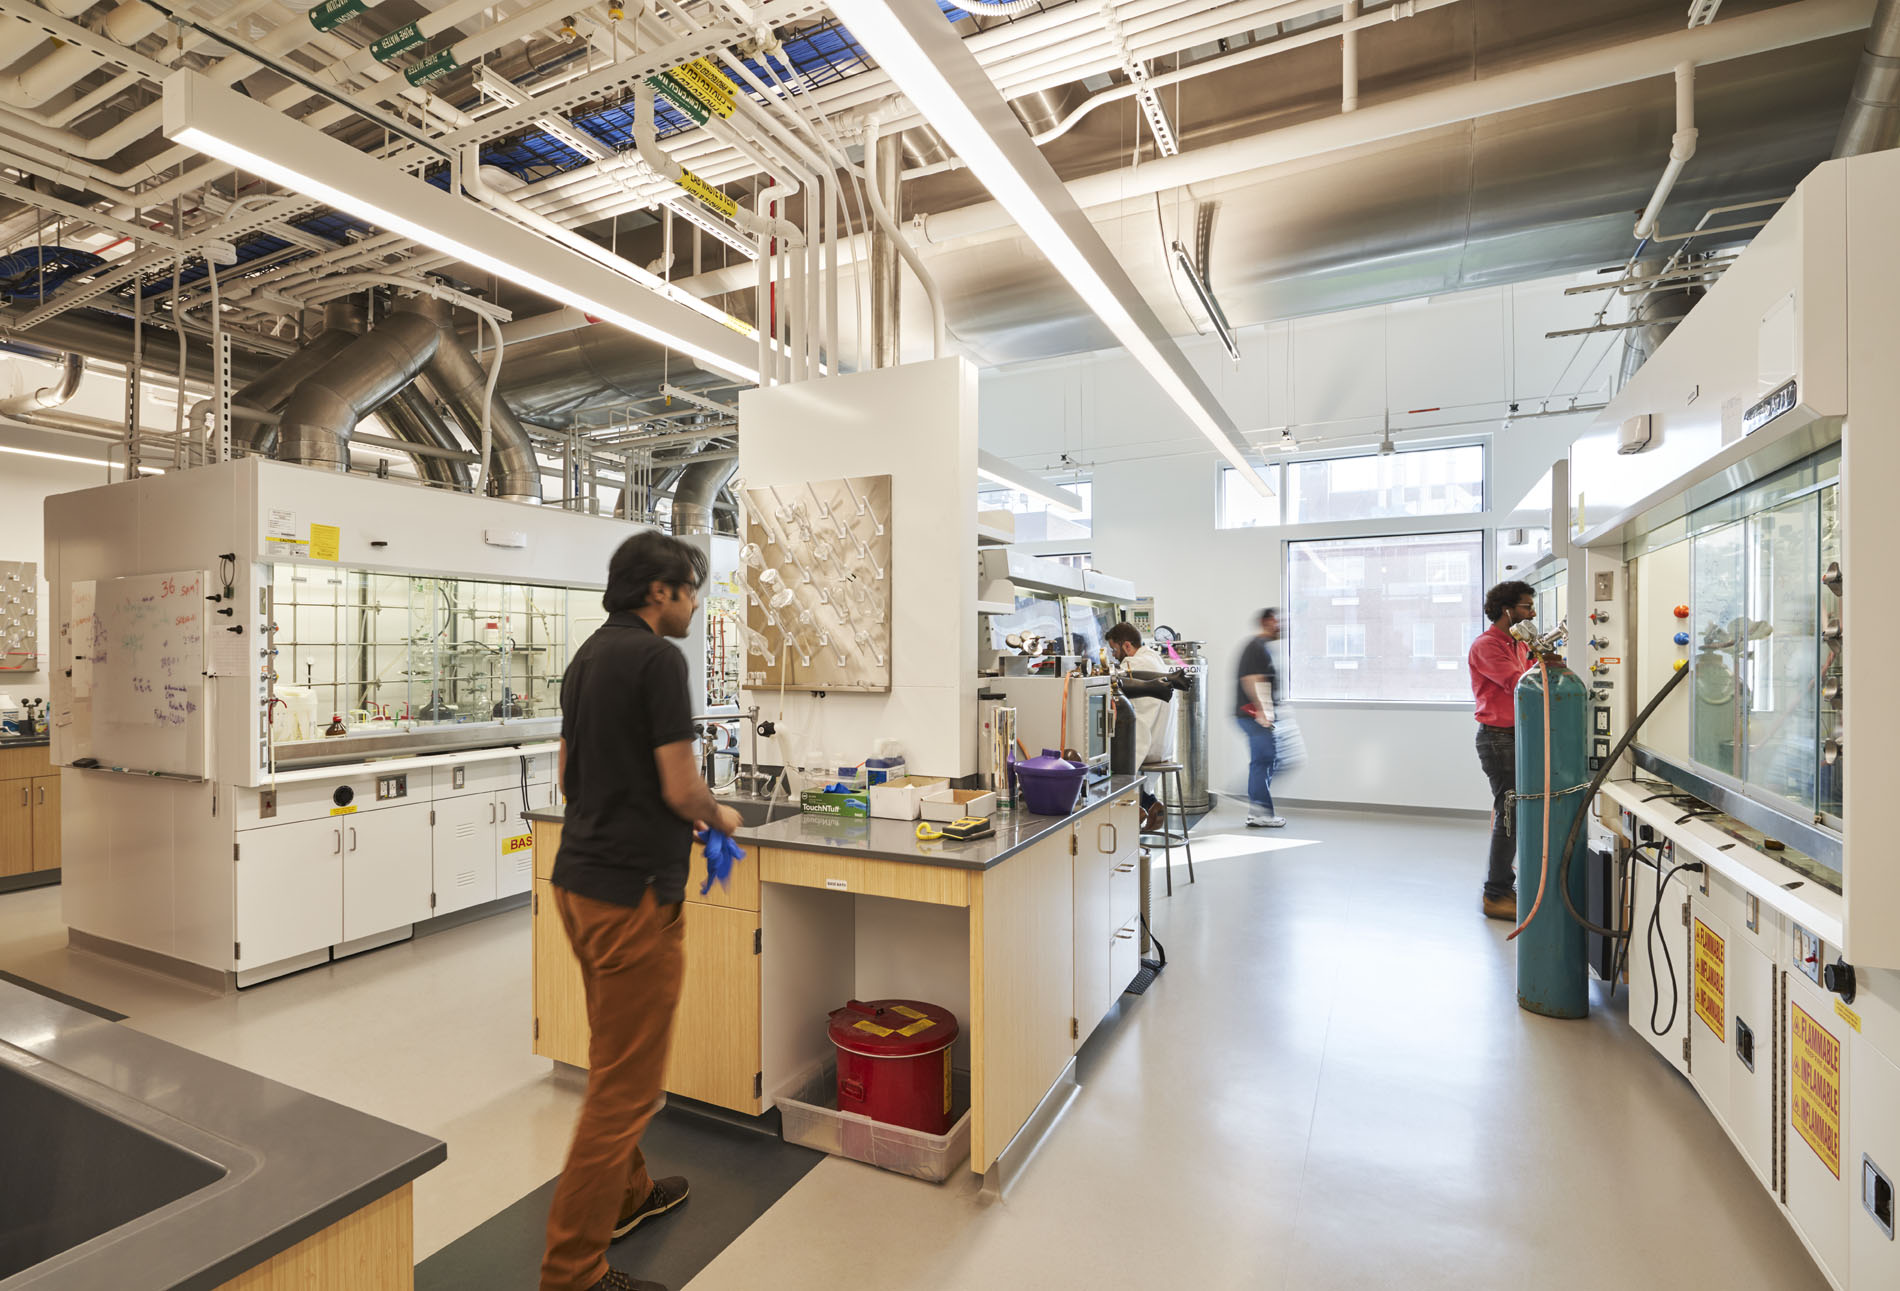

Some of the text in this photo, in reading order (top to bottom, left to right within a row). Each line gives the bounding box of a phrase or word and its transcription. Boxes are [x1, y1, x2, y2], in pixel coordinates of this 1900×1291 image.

[382, 26, 414, 49] PURE WATER
[802, 803, 840, 813] TouchNTuff
[510, 836, 532, 850] BAS
[1701, 926, 1724, 964] FLAMMABLE
[1801, 1016, 1838, 1072] FLAMMABLE
[1801, 1055, 1838, 1116] INFLAMABLE
